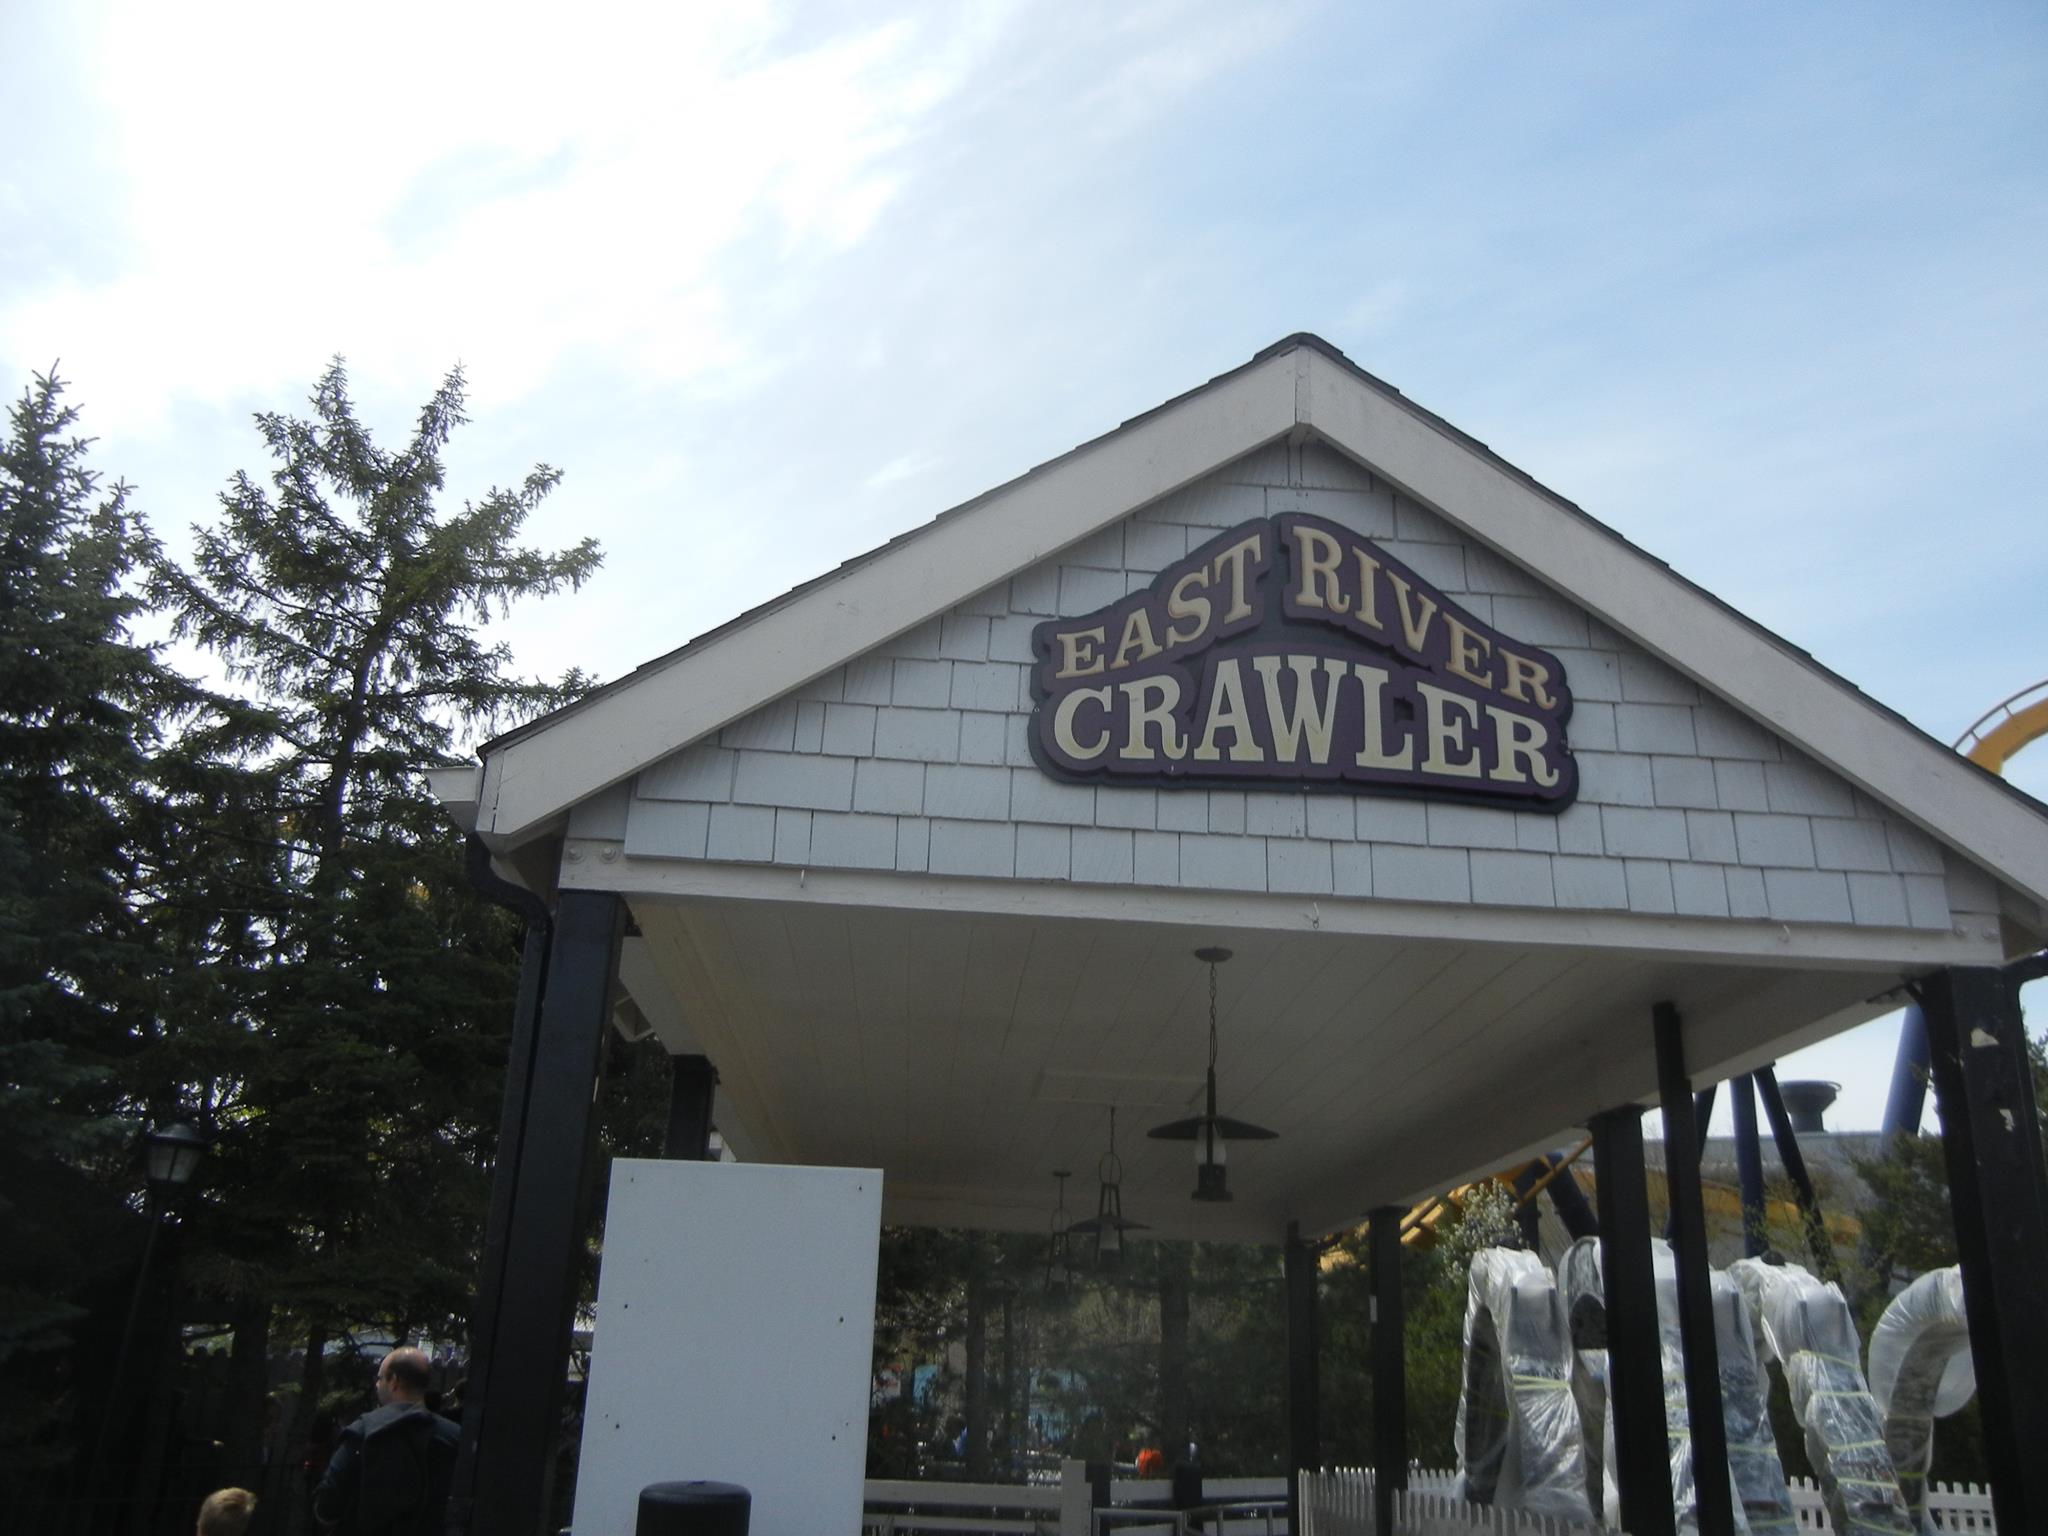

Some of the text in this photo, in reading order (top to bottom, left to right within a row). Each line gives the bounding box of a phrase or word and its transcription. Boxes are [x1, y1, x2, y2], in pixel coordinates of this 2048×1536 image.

[1055, 525, 1557, 710] EAST RIVER
[1053, 654, 1560, 788] CRAWLER
